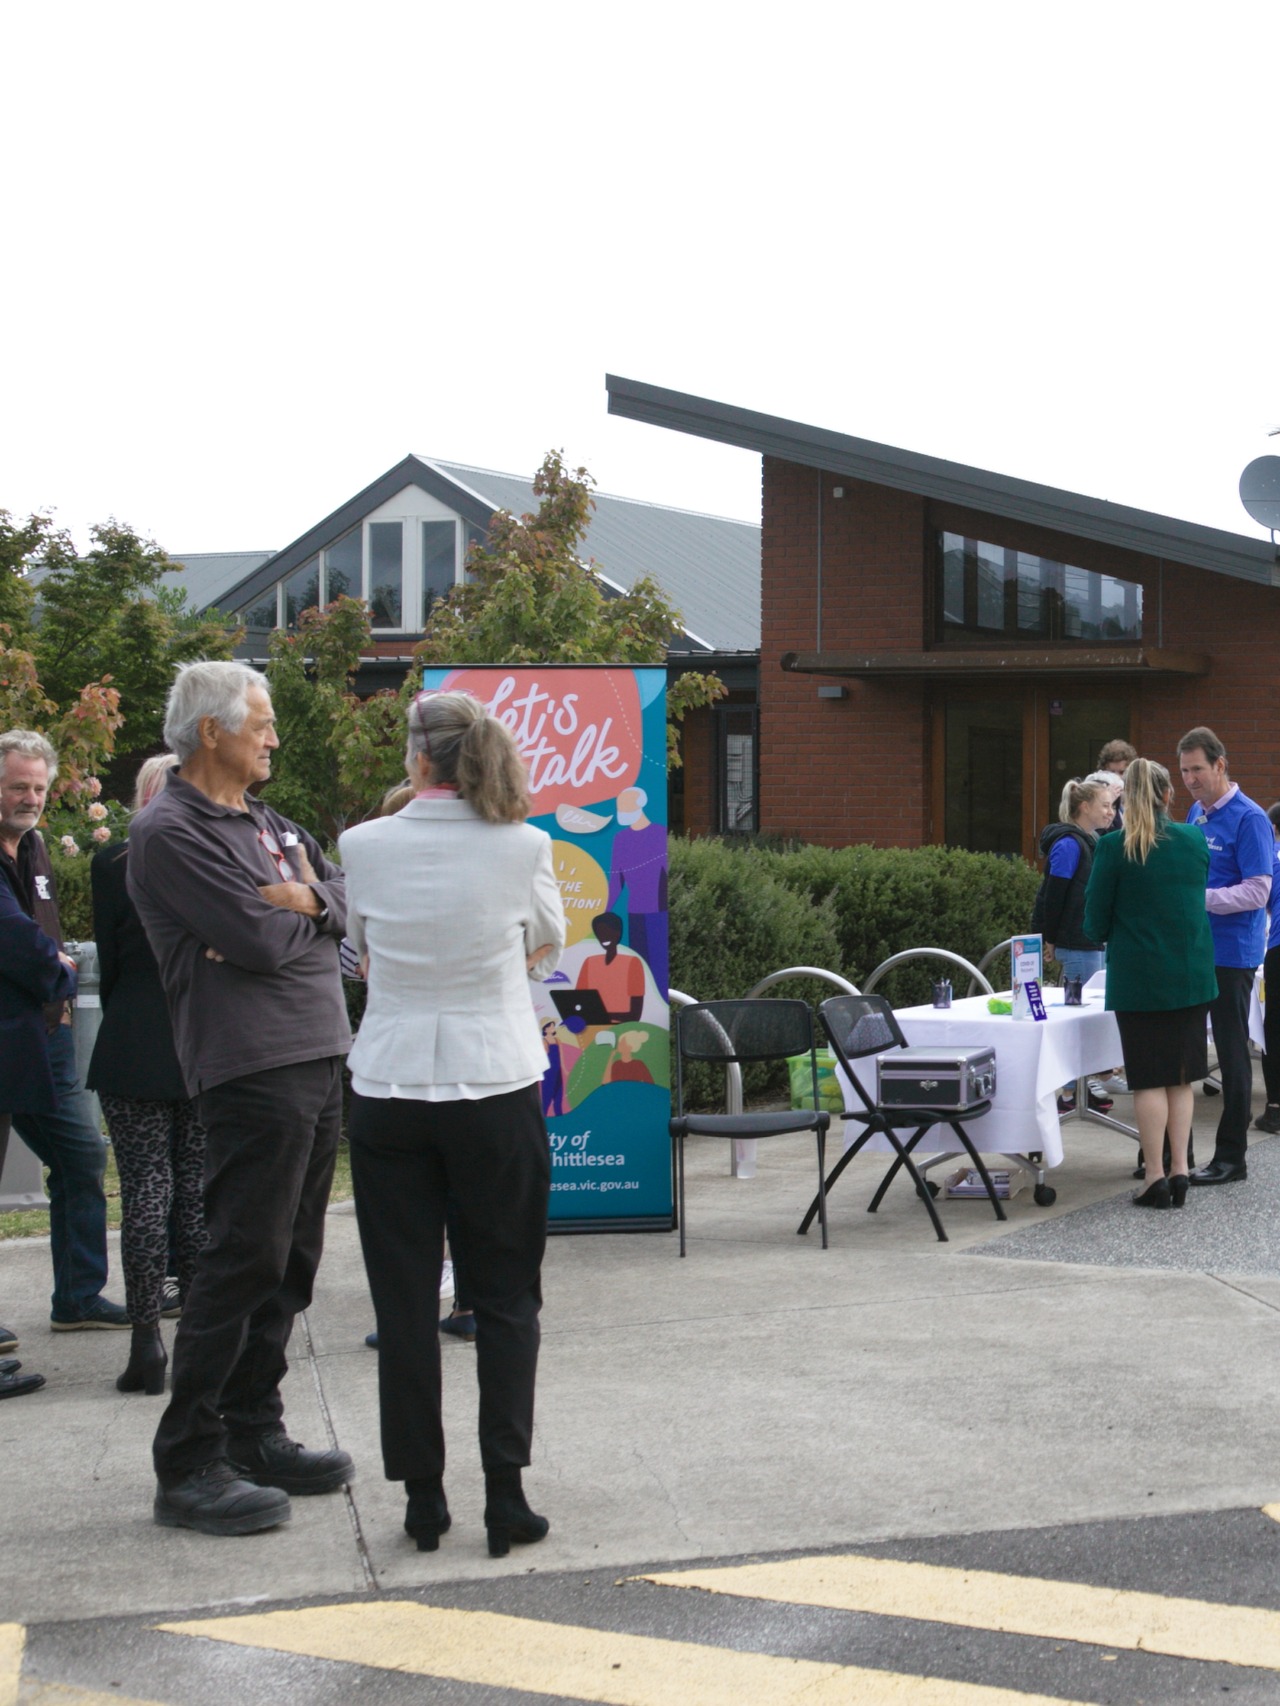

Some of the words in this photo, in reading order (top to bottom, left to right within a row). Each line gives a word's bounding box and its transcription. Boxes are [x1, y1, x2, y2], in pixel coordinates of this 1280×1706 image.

[521, 717, 629, 794] talk
[556, 881, 583, 892] THE
[570, 1130, 591, 1151] of
[552, 1151, 625, 1167] hittlesea
[549, 1180, 640, 1193] esea.vic.gov.au
